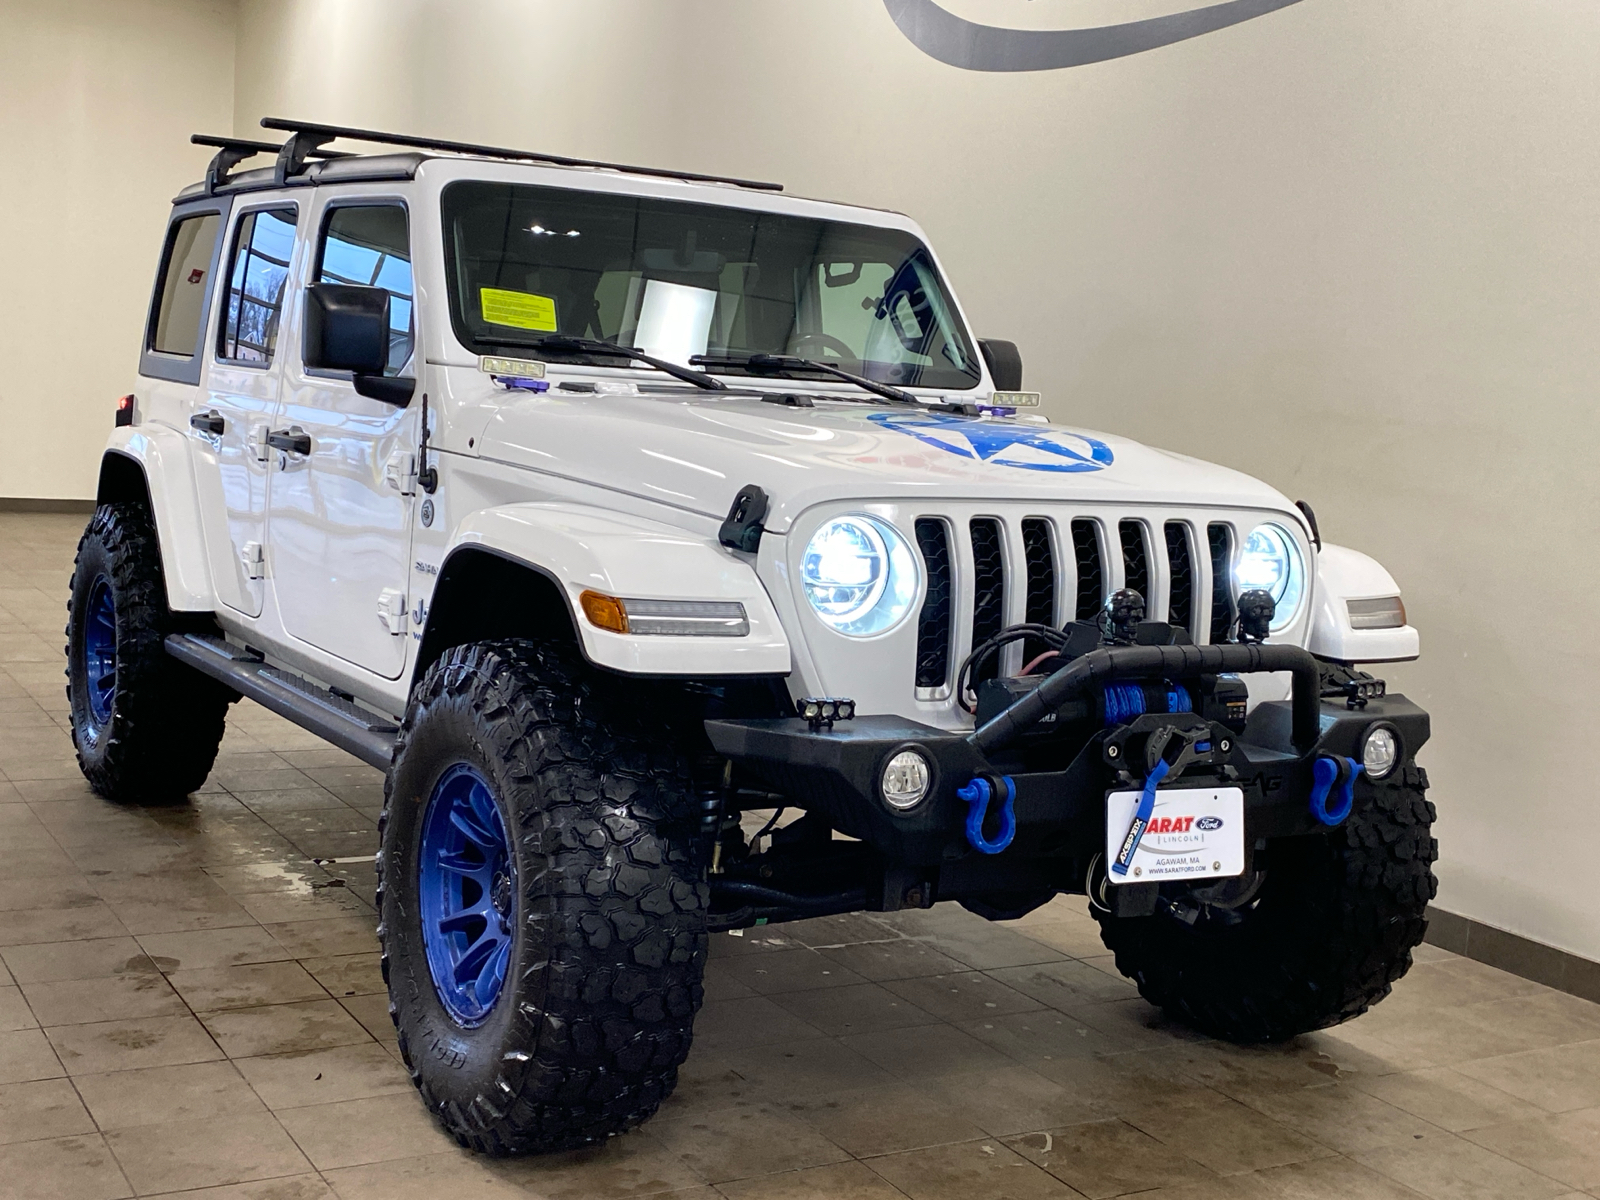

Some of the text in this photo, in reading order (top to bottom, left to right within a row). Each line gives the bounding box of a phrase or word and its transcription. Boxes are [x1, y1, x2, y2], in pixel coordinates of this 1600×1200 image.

[1144, 815, 1195, 834] ARAT
[1199, 818, 1219, 830] Ford
[1163, 835, 1199, 843] LINCOLN
[1156, 858, 1189, 866] AGAWAM,
[1149, 866, 1206, 875] WWW.SARATFORD.COM
